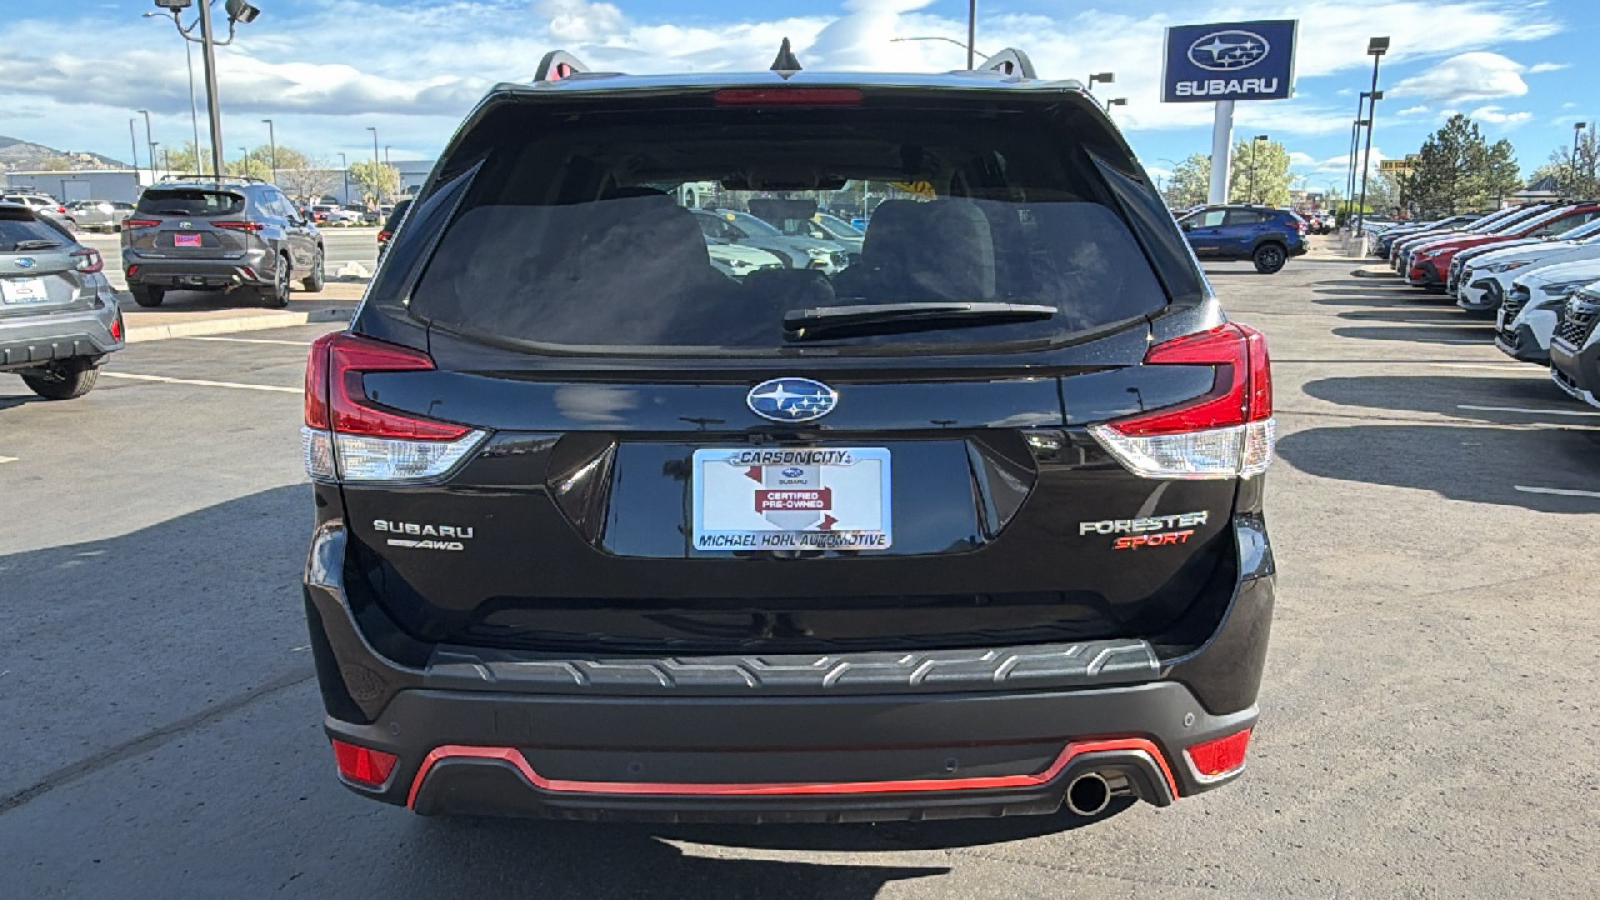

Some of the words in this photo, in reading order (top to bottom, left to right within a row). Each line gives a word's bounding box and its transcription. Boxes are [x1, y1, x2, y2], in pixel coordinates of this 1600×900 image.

[1175, 77, 1278, 96] SUBARU
[740, 451, 806, 463] CARSON
[809, 450, 847, 463] CITY
[767, 492, 819, 500] CERTIFIED
[762, 500, 825, 508] PRE-OWNED
[373, 519, 474, 538] SUBARU
[1079, 510, 1209, 536] FORESTER
[415, 540, 464, 550] AWD
[699, 534, 757, 546] MICHAEL
[761, 534, 796, 546] HOHL
[800, 534, 886, 547] AUTOMOTIVE
[1112, 529, 1195, 550] SPORT
